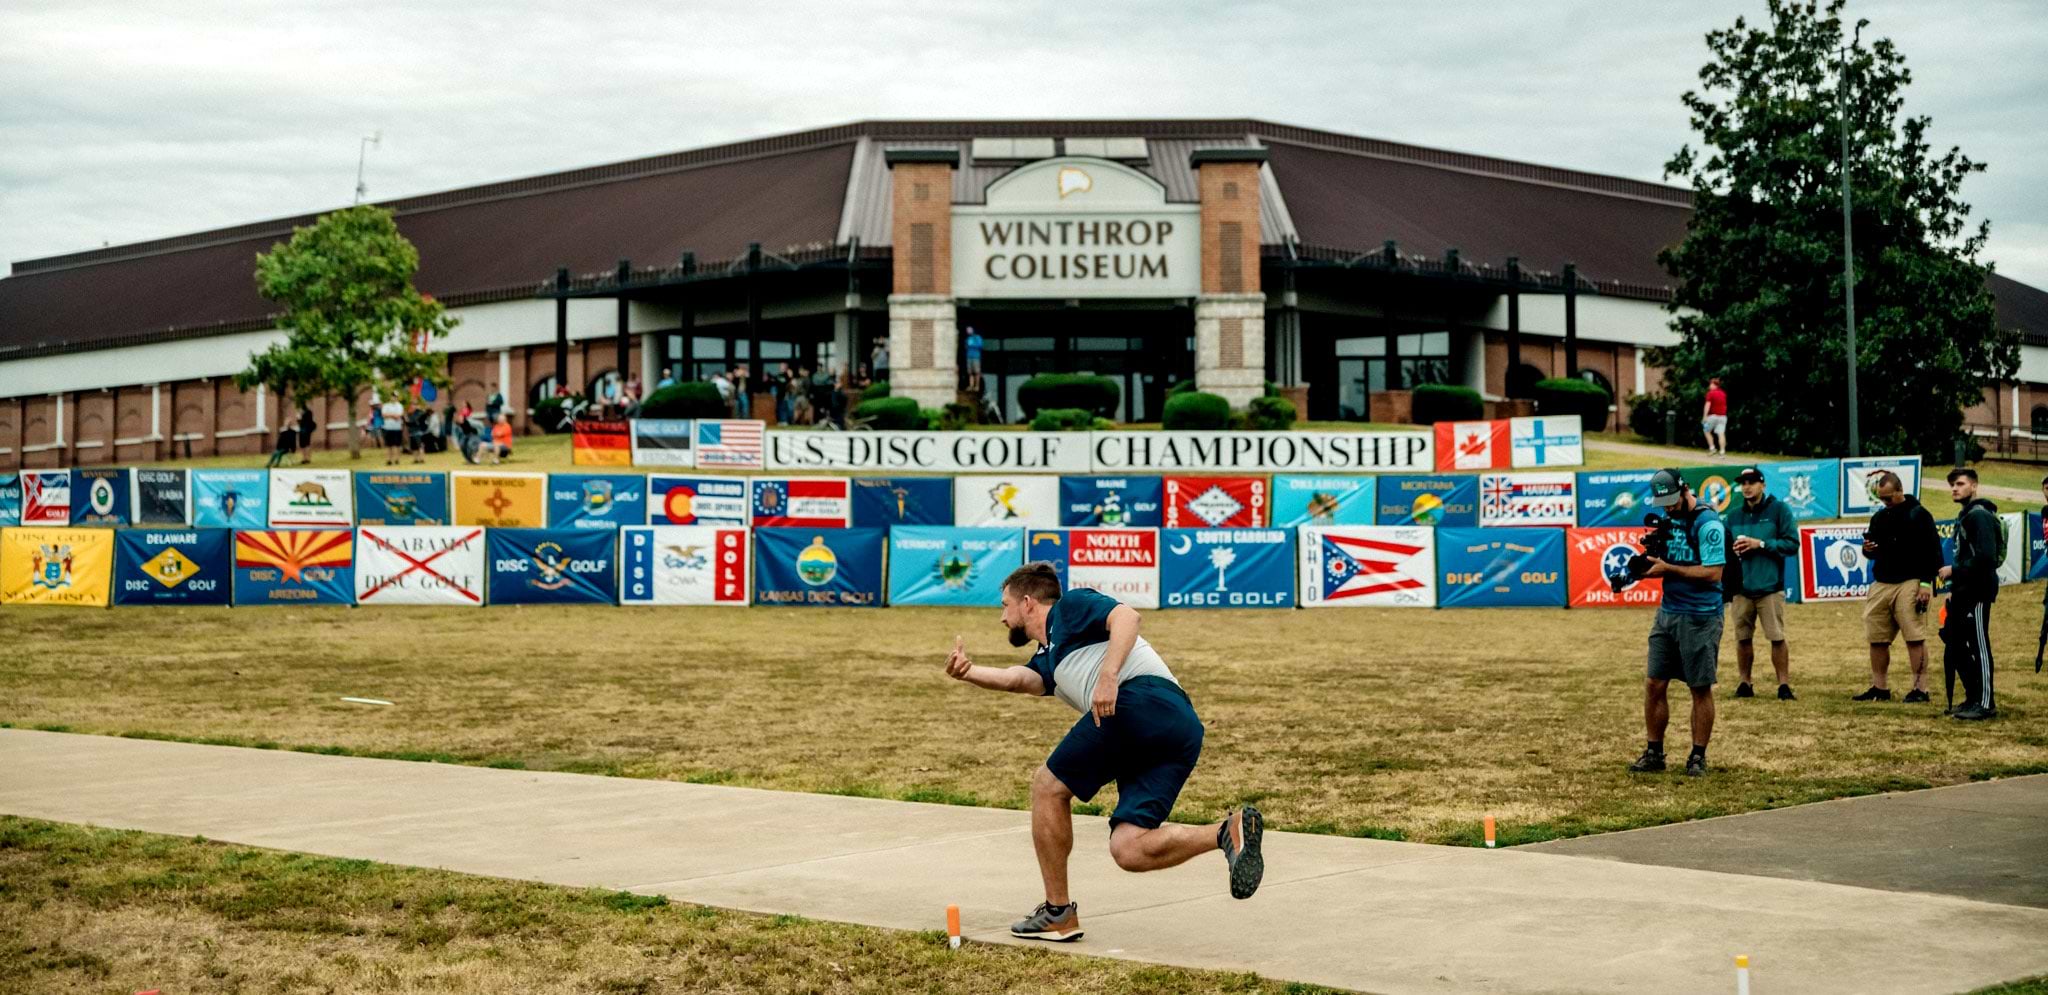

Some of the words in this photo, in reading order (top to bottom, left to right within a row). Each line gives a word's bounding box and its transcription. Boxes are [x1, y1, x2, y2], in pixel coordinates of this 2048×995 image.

[980, 220, 1174, 246] WINTHROP
[985, 254, 1169, 280] COLISEUM
[772, 436, 833, 466] U.S.
[847, 436, 936, 466] DISC
[952, 436, 1061, 467] GOLF
[1096, 436, 1427, 467] CHAMPIONSHIP
[1445, 504, 1473, 514] GOLF
[1585, 499, 1606, 508] DISC
[1485, 505, 1523, 519] DISC
[1527, 503, 1573, 518] GOLF
[146, 534, 198, 544] DELAWARE
[1195, 531, 1231, 543] SOUTH
[1233, 530, 1285, 543] CAROLINA
[1814, 528, 1868, 540] WYOMIN
[373, 538, 470, 551] ALABAMA
[896, 539, 947, 549] VERMONT
[1086, 534, 1140, 548] NORTH
[1072, 549, 1152, 563] CAROLINA
[496, 560, 528, 572] DISC
[571, 560, 607, 572] GOLF
[634, 534, 645, 595] DISC
[724, 534, 737, 596] GOLF
[250, 570, 276, 581] DISC
[365, 575, 408, 589] DISC
[420, 575, 474, 589] GOLF
[1446, 572, 1483, 584] DISC
[1521, 572, 1558, 584] GOLF
[126, 580, 149, 590] DISC
[188, 580, 216, 590] GOLF
[1113, 581, 1152, 594] GOLF
[1818, 585, 1846, 597] DISC
[269, 590, 317, 599] ARIZONA
[759, 591, 804, 602] KANSAS
[808, 591, 836, 603] DISC
[840, 591, 874, 604] GOLF
[1168, 592, 1220, 605] DISC
[1229, 592, 1287, 605] GOLF
[1586, 591, 1618, 602] DISC
[1624, 591, 1659, 602] GOLF
